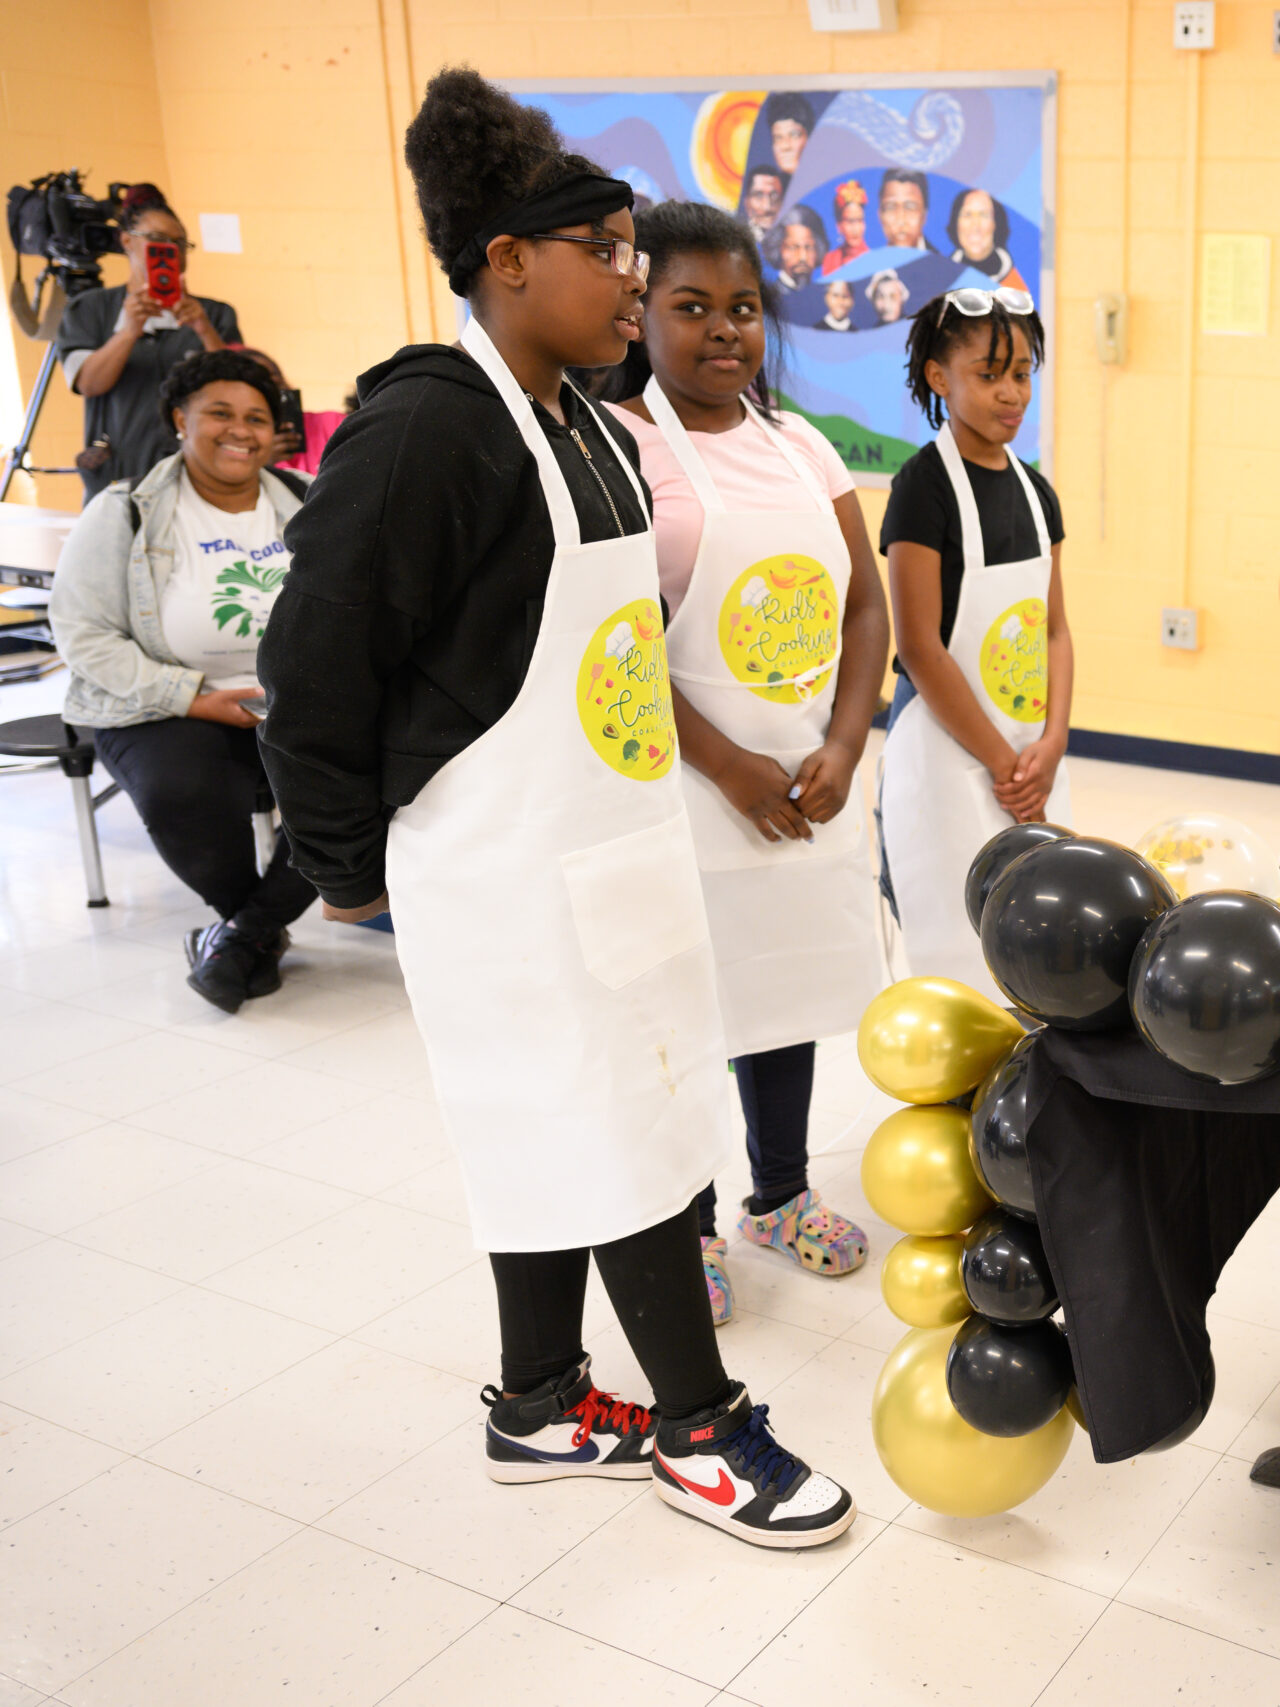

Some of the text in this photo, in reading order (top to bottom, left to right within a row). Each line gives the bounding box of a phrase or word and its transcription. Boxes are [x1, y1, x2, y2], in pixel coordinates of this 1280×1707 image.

[198, 539, 244, 555] TEA
[753, 589, 817, 625] Kids
[748, 623, 833, 663] Cooking
[690, 1425, 715, 1443] NIKE
